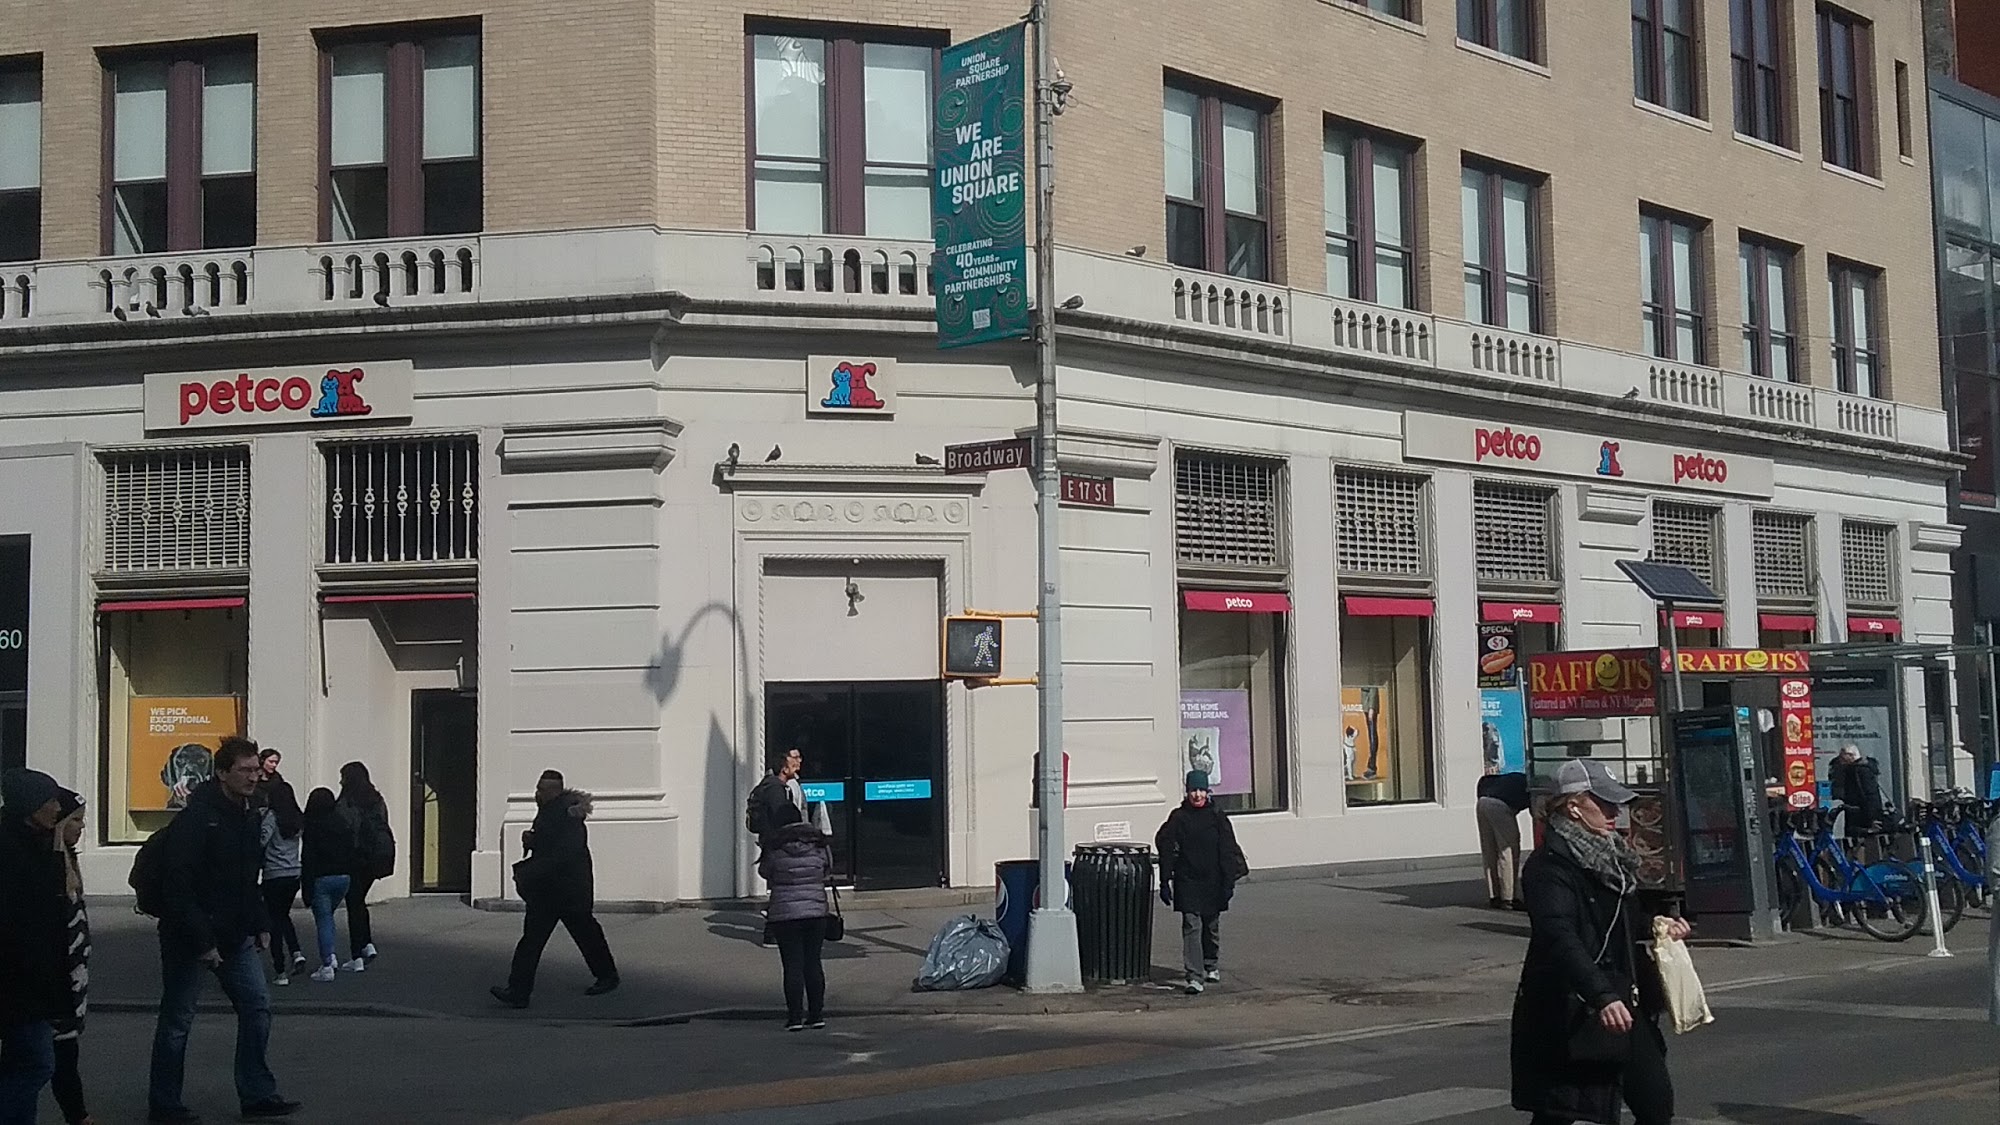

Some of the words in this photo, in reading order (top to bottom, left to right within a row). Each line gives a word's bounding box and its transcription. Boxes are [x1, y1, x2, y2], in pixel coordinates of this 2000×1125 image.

[961, 51, 987, 67] UNION
[969, 57, 1001, 75] SQUARE
[956, 64, 1010, 88] PARTNERSHIP
[956, 122, 982, 145] WE
[971, 136, 1003, 161] ARE
[941, 158, 993, 188] UNION
[952, 172, 1020, 205] SQUARE
[946, 238, 993, 255] CELEBRATING
[956, 252, 974, 268] 40
[973, 254, 995, 266] YEARS
[963, 259, 1018, 279] COMMUNITY
[945, 273, 1012, 295] PARTNERSHIPS
[180, 373, 312, 425] petco
[1475, 426, 1541, 462] petco
[947, 446, 1024, 469] Broadway
[1673, 452, 1727, 485] petco
[1067, 480, 1074, 499] E
[1079, 482, 1090, 500] 17
[1095, 484, 1107, 502] St
[1225, 597, 1253, 609] petco
[1481, 626, 1514, 635] SPECIAL
[1492, 637, 1504, 649] $1
[1787, 683, 1805, 695] Beef
[1201, 703, 1219, 711] HOME
[1531, 696, 1559, 709] Featured
[1581, 696, 1600, 709] Times
[150, 707, 165, 716] WE
[166, 707, 188, 716] PICK
[150, 716, 211, 724] EXCEPTIONAL
[150, 724, 175, 732] FOOD
[1792, 793, 1811, 805] Bites
